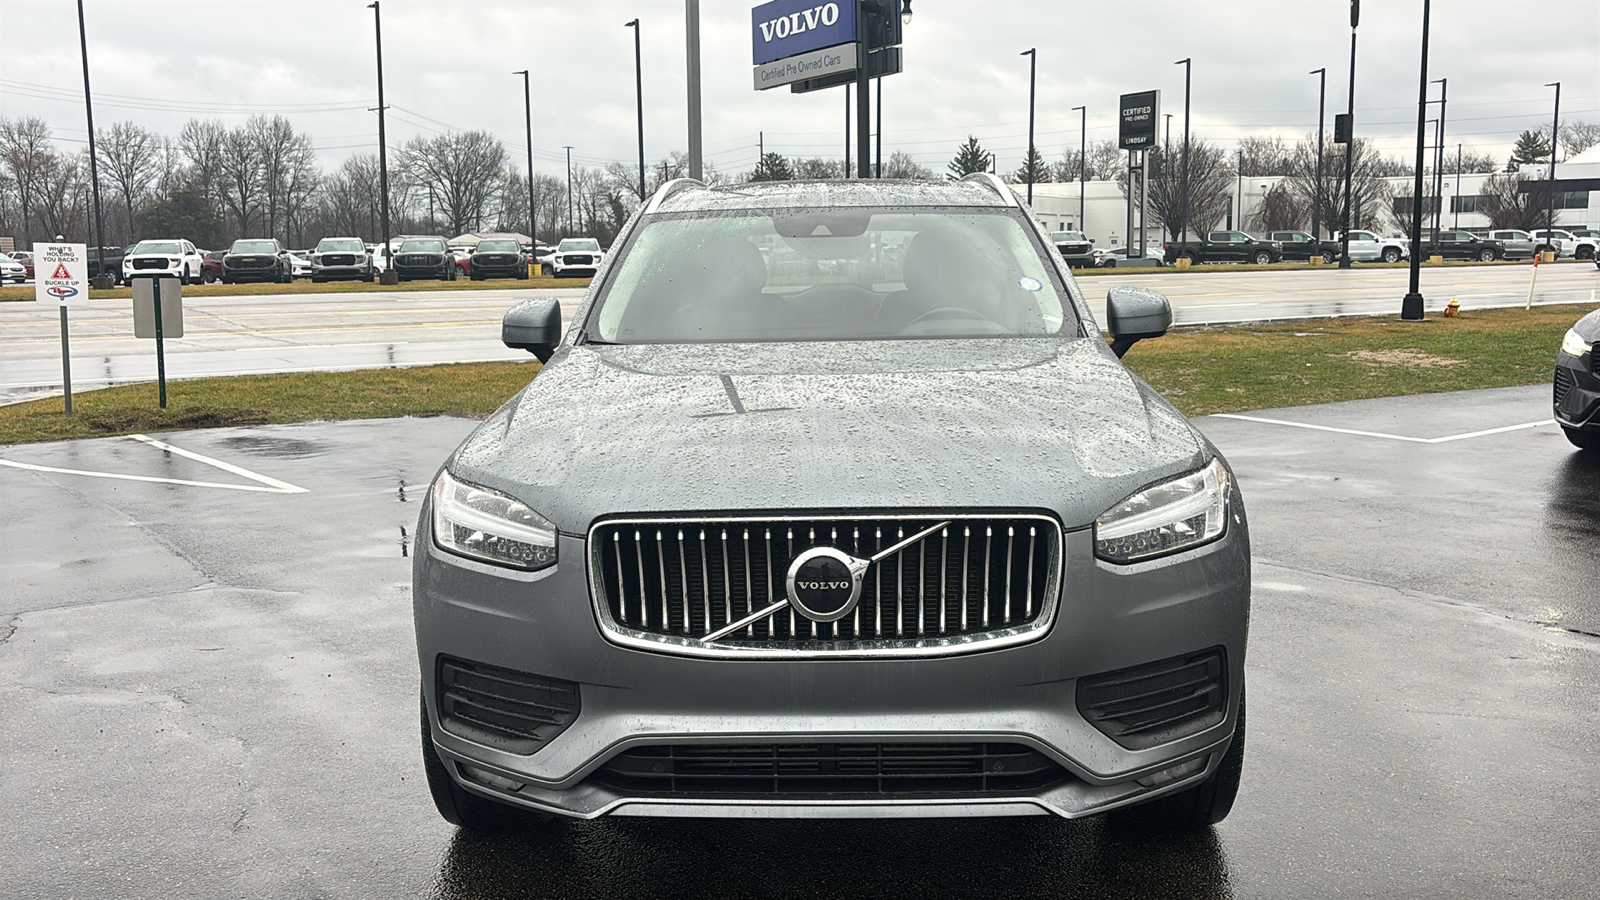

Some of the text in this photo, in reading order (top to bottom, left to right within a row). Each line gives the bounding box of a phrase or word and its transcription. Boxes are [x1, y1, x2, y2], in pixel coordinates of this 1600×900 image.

[759, 2, 839, 42] VOLVO
[761, 54, 841, 82] Certified Pre Owned Cars
[1123, 106, 1151, 116] CERTIFIED
[797, 581, 849, 589] VOLVO
